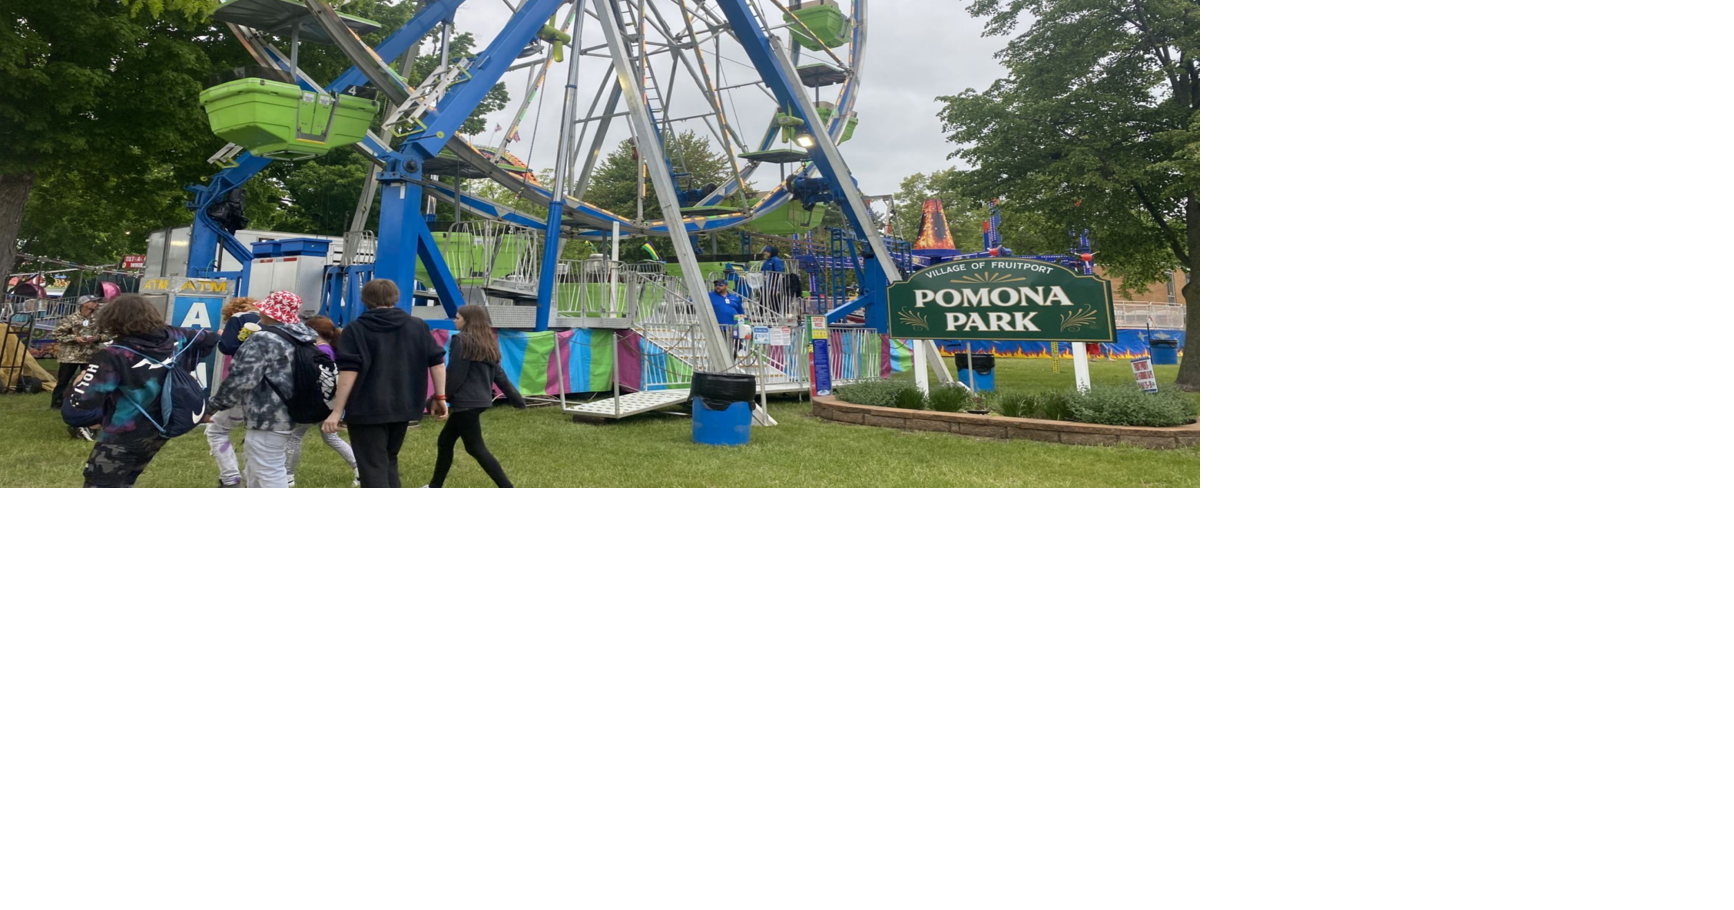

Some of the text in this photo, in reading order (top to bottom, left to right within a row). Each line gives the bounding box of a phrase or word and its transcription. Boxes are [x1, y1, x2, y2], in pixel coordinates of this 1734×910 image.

[349, 85, 357, 96] 4
[925, 261, 1054, 279] VILLAGE OF FRUITPORT
[144, 279, 169, 290] ATM
[181, 280, 227, 293] ATM
[913, 286, 1074, 308] POMONA
[944, 311, 1042, 332] PARK
